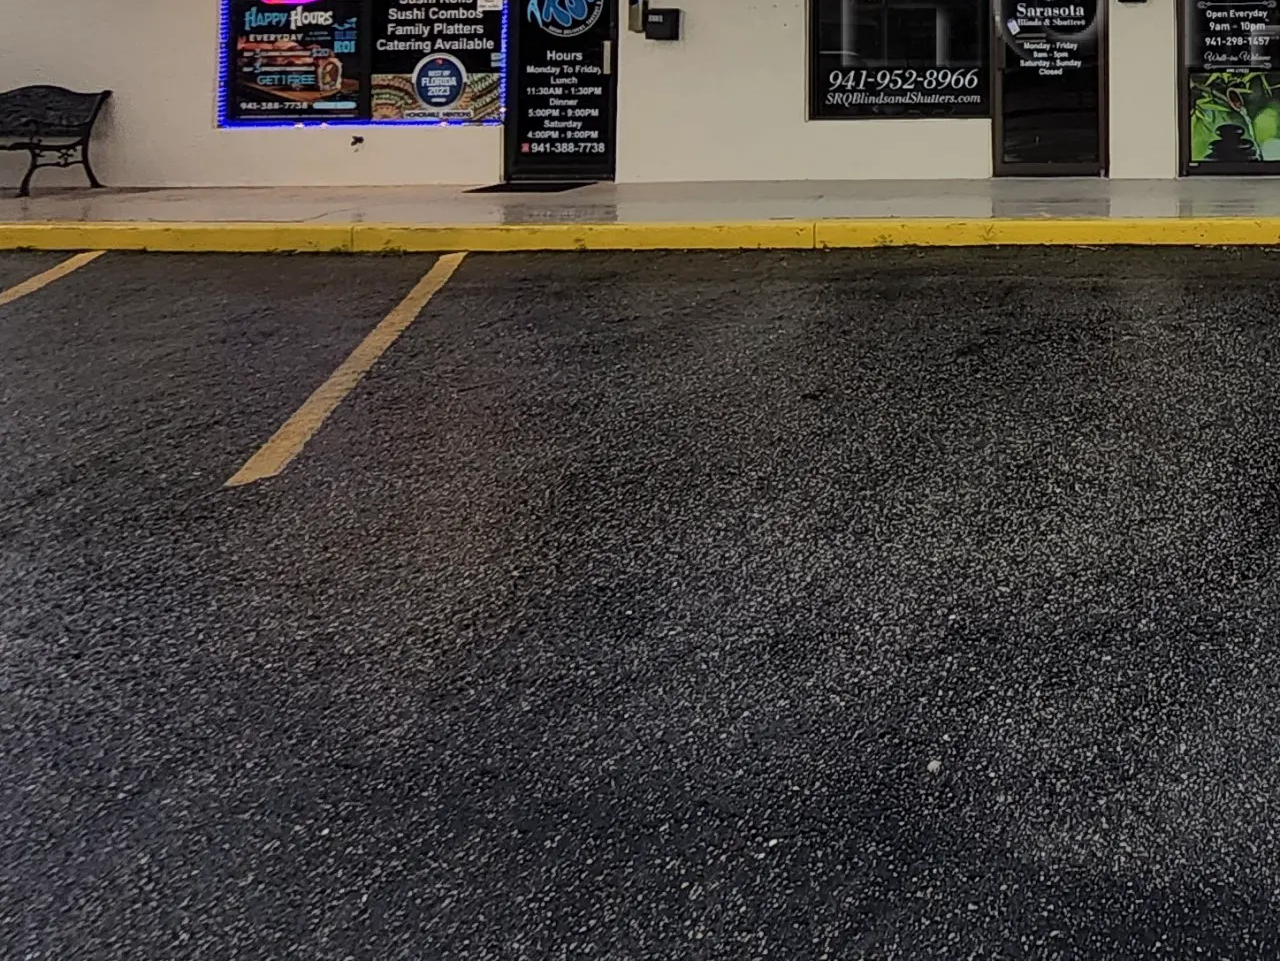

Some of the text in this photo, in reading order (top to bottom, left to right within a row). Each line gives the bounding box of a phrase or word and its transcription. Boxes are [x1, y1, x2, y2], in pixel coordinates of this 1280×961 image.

[388, 7, 483, 20] Sushi Combos
[1016, 3, 1085, 17] Sarasota
[1206, 9, 1268, 19] Open Everyday
[387, 23, 484, 38] Family Platters
[1209, 22, 1230, 31] 9am
[1240, 21, 1266, 32] 10pm
[249, 34, 303, 42] EVERYDAY
[1205, 37, 1270, 46] 941-298-1457
[376, 38, 494, 53] Catering Available
[1024, 42, 1050, 50] Monday
[1056, 42, 1078, 50] Friday
[546, 50, 583, 61] Hours
[1020, 59, 1050, 68] Saturday
[1056, 59, 1081, 68] Sunday
[527, 65, 601, 75] Monday To Friday
[550, 76, 578, 84] Lunch
[828, 68, 979, 90] 941-952-8966
[427, 86, 450, 96] 2023
[527, 87, 562, 95] 11:30AM
[571, 87, 602, 95] 1:30PM
[549, 98, 578, 106] Dinner
[825, 92, 981, 107] SRQBlindsandShutters.com
[528, 109, 559, 117] 5:00PM
[567, 109, 599, 117] 9:00PM
[543, 120, 582, 129] Saturday
[527, 131, 559, 139] 4:00PM
[531, 142, 605, 153] 941-388-7738
